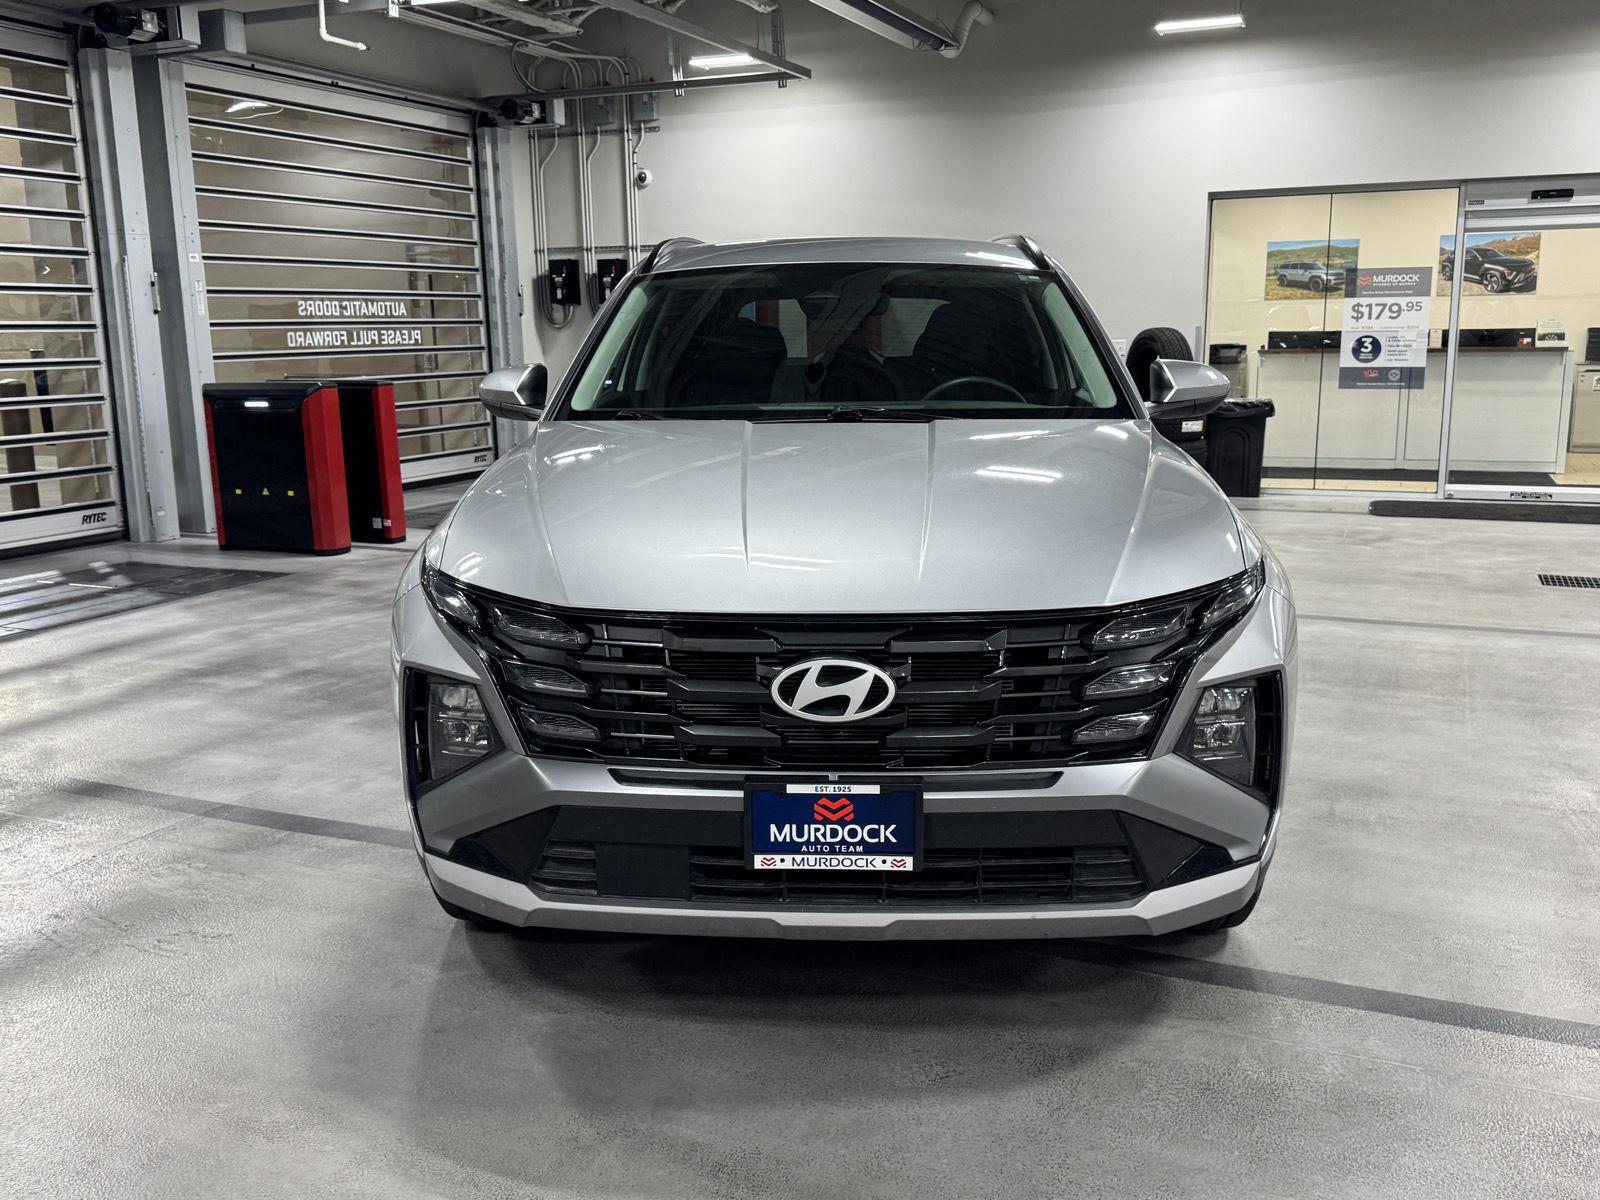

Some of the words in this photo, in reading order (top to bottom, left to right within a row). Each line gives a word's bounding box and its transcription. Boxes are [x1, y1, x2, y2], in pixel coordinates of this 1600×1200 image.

[1373, 274, 1420, 283] MURDOCK
[1360, 337, 1373, 353] 3
[82, 512, 107, 525] RYTEC
[770, 824, 898, 843] MURDOCK
[801, 845, 830, 853] AUTO
[834, 845, 864, 853] TEAM
[791, 857, 876, 868] MURDOCK
